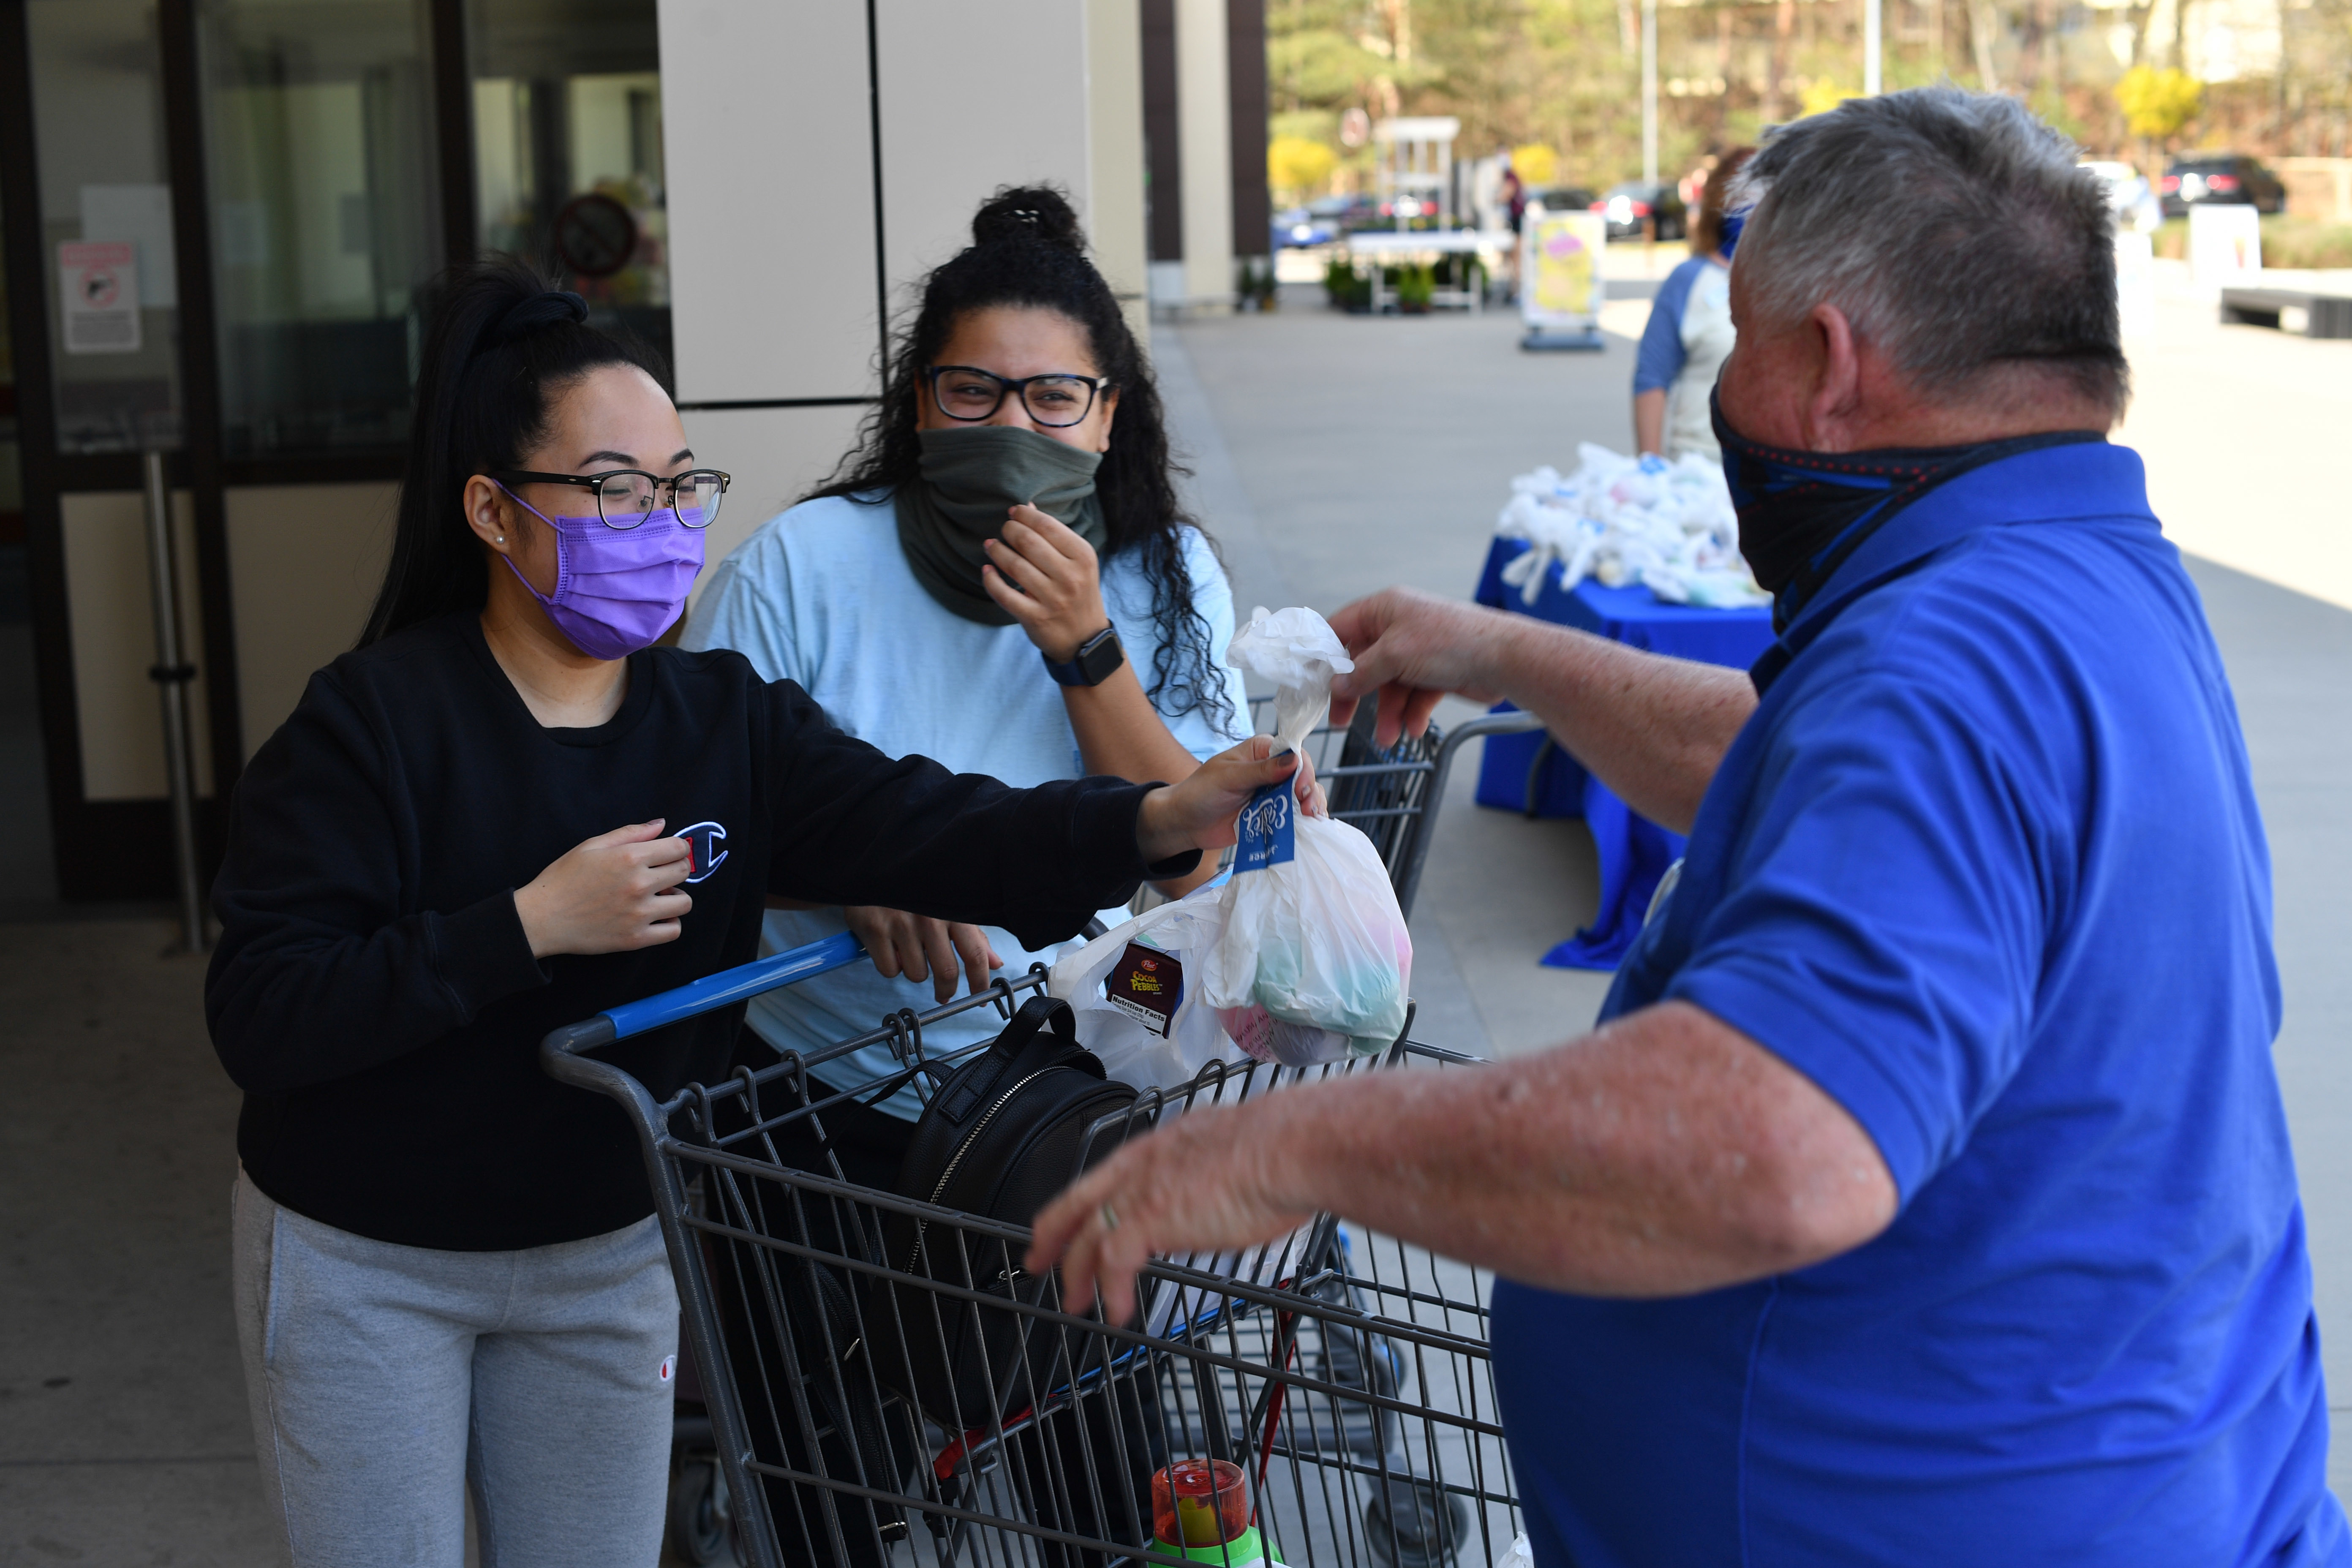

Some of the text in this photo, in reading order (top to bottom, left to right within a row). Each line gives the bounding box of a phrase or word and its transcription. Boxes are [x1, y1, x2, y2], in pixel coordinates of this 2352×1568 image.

[1243, 795, 1288, 844] Easter
[1130, 978, 1160, 991] PEBBLES
[1132, 971, 1157, 983] COCOA
[1113, 996, 1165, 1022] Nutrition Facts
